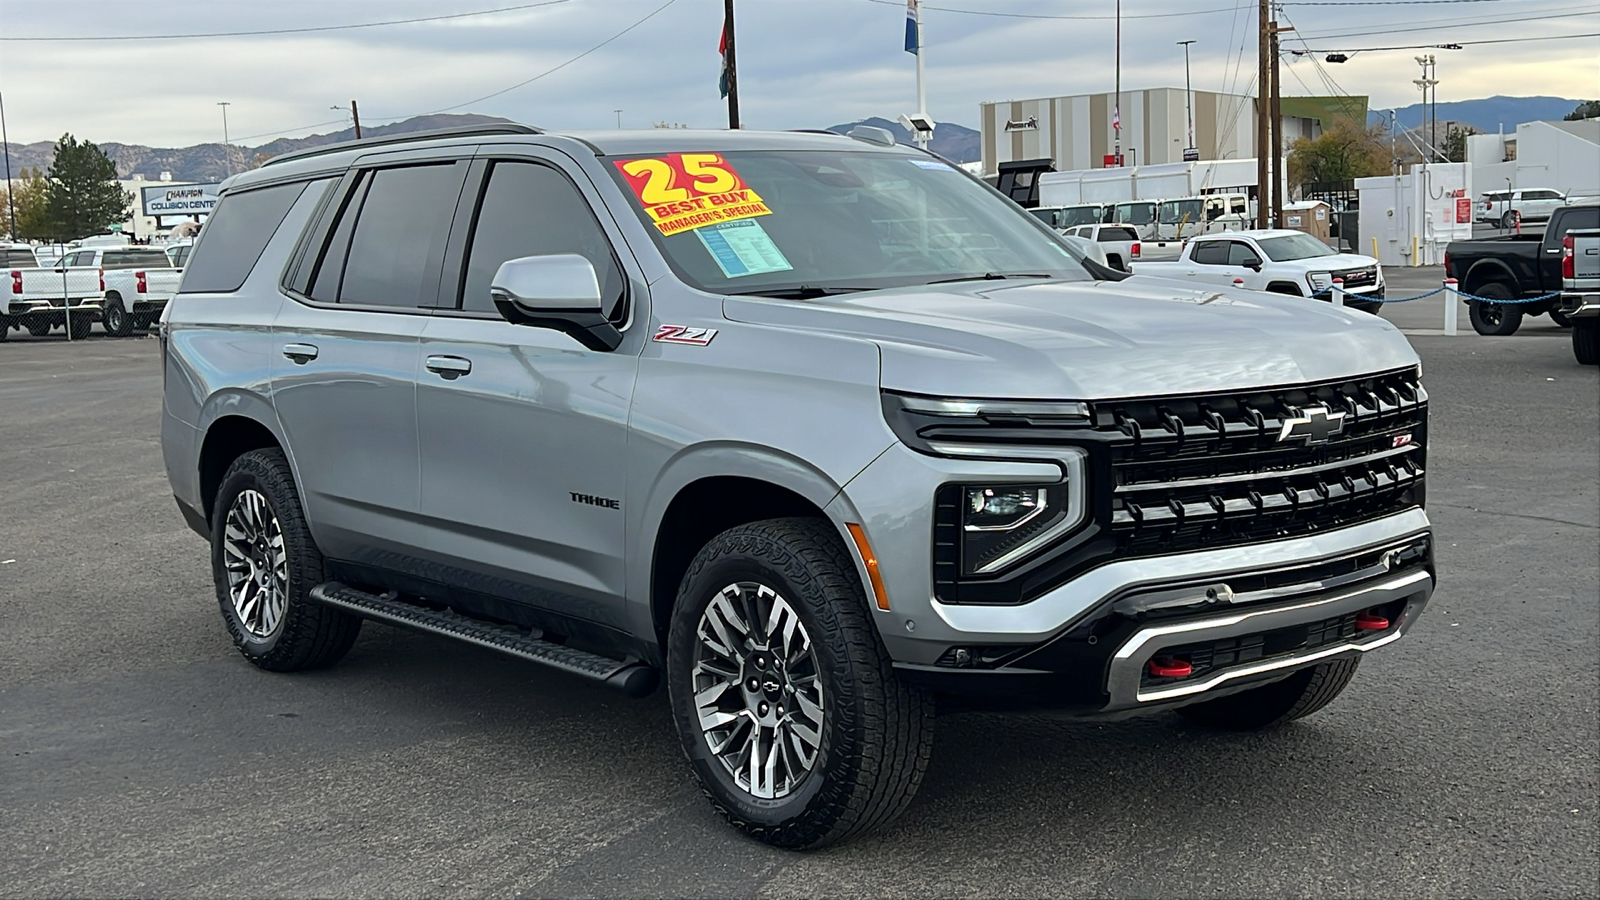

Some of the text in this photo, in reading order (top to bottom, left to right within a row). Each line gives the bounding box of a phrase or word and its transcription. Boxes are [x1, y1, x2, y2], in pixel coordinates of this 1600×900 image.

[623, 153, 741, 206] 25
[151, 201, 189, 210] COLLISION
[166, 189, 203, 201] CHAMPION
[654, 190, 750, 220] BEST BUY
[657, 203, 767, 234] MANAGER'S SPECIAL
[716, 221, 753, 229] CERTIFIED
[652, 324, 719, 346] Z71
[569, 491, 620, 511] TAHOE
